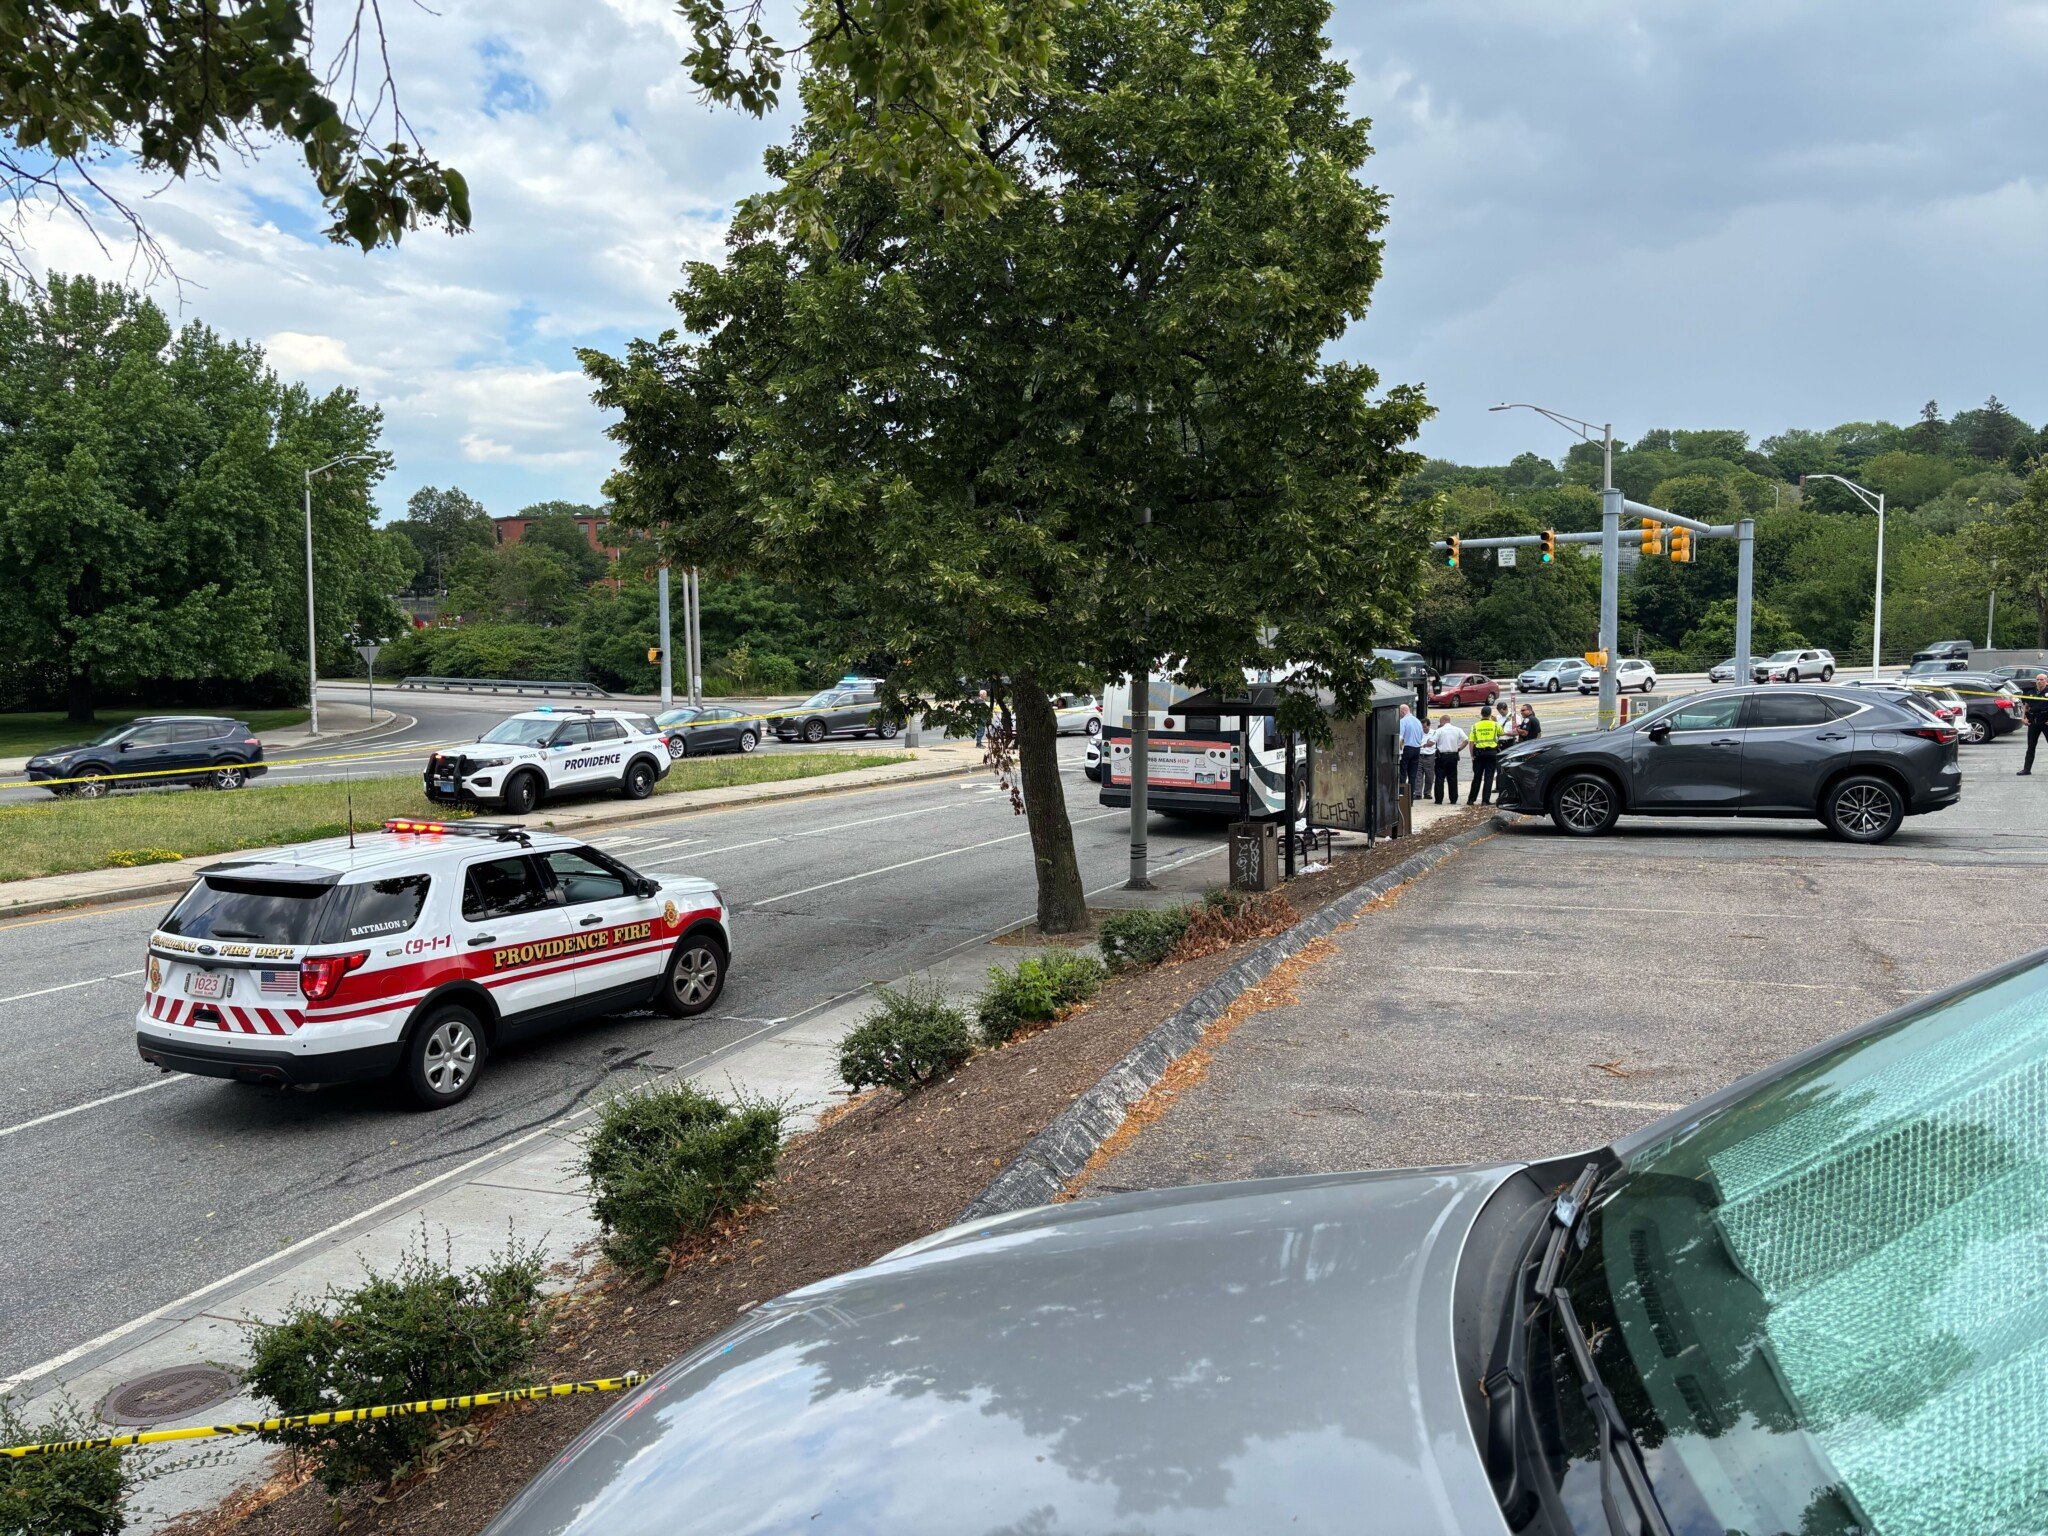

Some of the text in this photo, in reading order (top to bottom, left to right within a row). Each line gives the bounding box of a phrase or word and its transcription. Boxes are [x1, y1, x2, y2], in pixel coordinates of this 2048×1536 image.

[564, 753, 621, 770] PROVIDENCE
[350, 919, 408, 936] BATTALION 3
[219, 944, 252, 957] FIRE
[494, 922, 651, 968] PROVIDENCE FIRE
[194, 977, 219, 991] 1023
